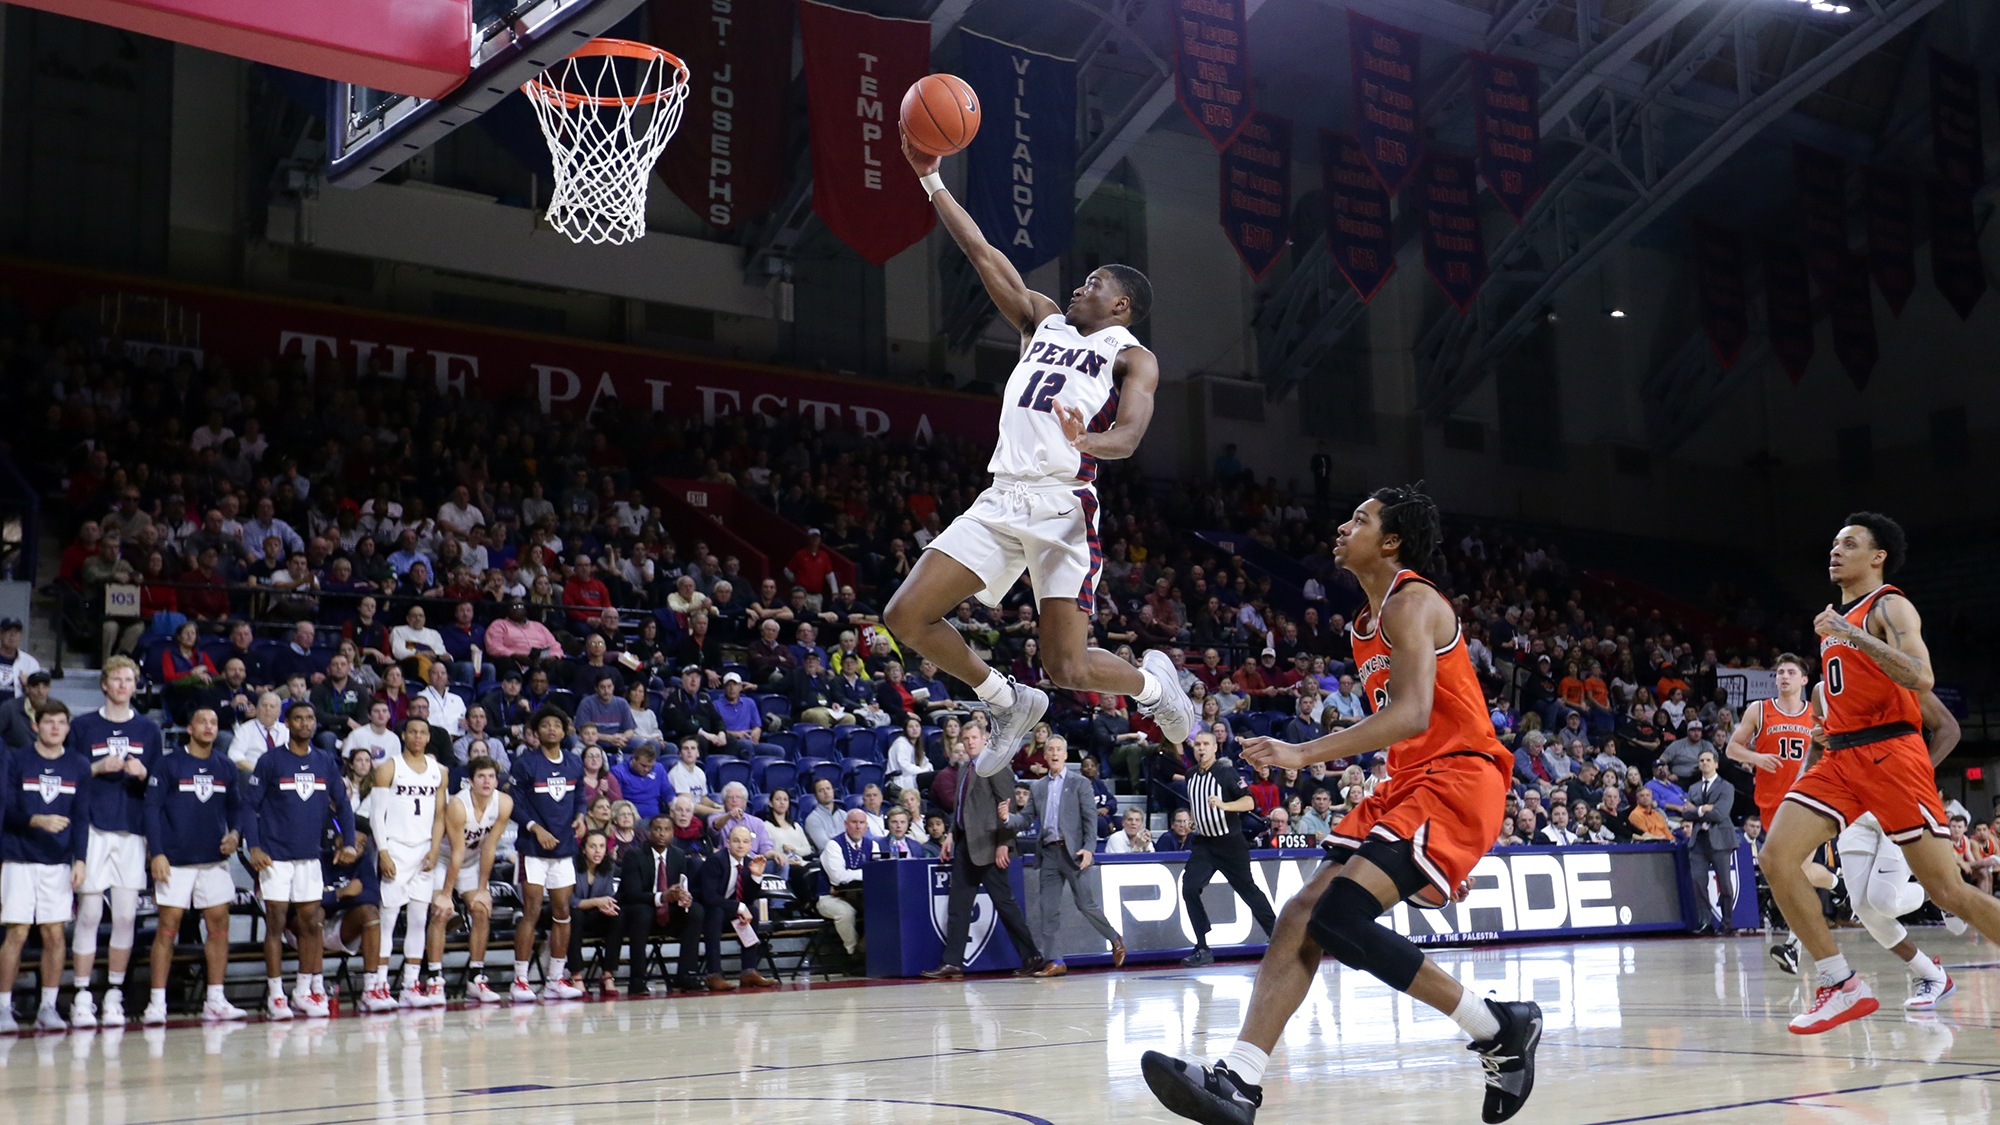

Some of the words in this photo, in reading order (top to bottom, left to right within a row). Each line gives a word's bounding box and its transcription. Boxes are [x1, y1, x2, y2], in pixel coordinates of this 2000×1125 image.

[857, 52, 883, 190] TEMPLE
[1201, 103, 1233, 128] 1979
[1012, 56, 1034, 249] VILLANOVA
[1375, 136, 1407, 166] 1975
[279, 331, 479, 398] THE
[1022, 341, 1108, 379] PENN
[1017, 369, 1067, 414] 12
[111, 592, 135, 606] 103
[1827, 656, 1845, 696] 0
[1778, 736, 1805, 761] 15
[414, 798, 421, 816] 1
[1278, 834, 1309, 848] POSS.
[760, 880, 788, 891] ENN
[1405, 935, 1427, 944] OURT
[1431, 934, 1442, 943] AT
[1444, 933, 1460, 942] THE
[1462, 931, 1500, 942] PALESTRA
